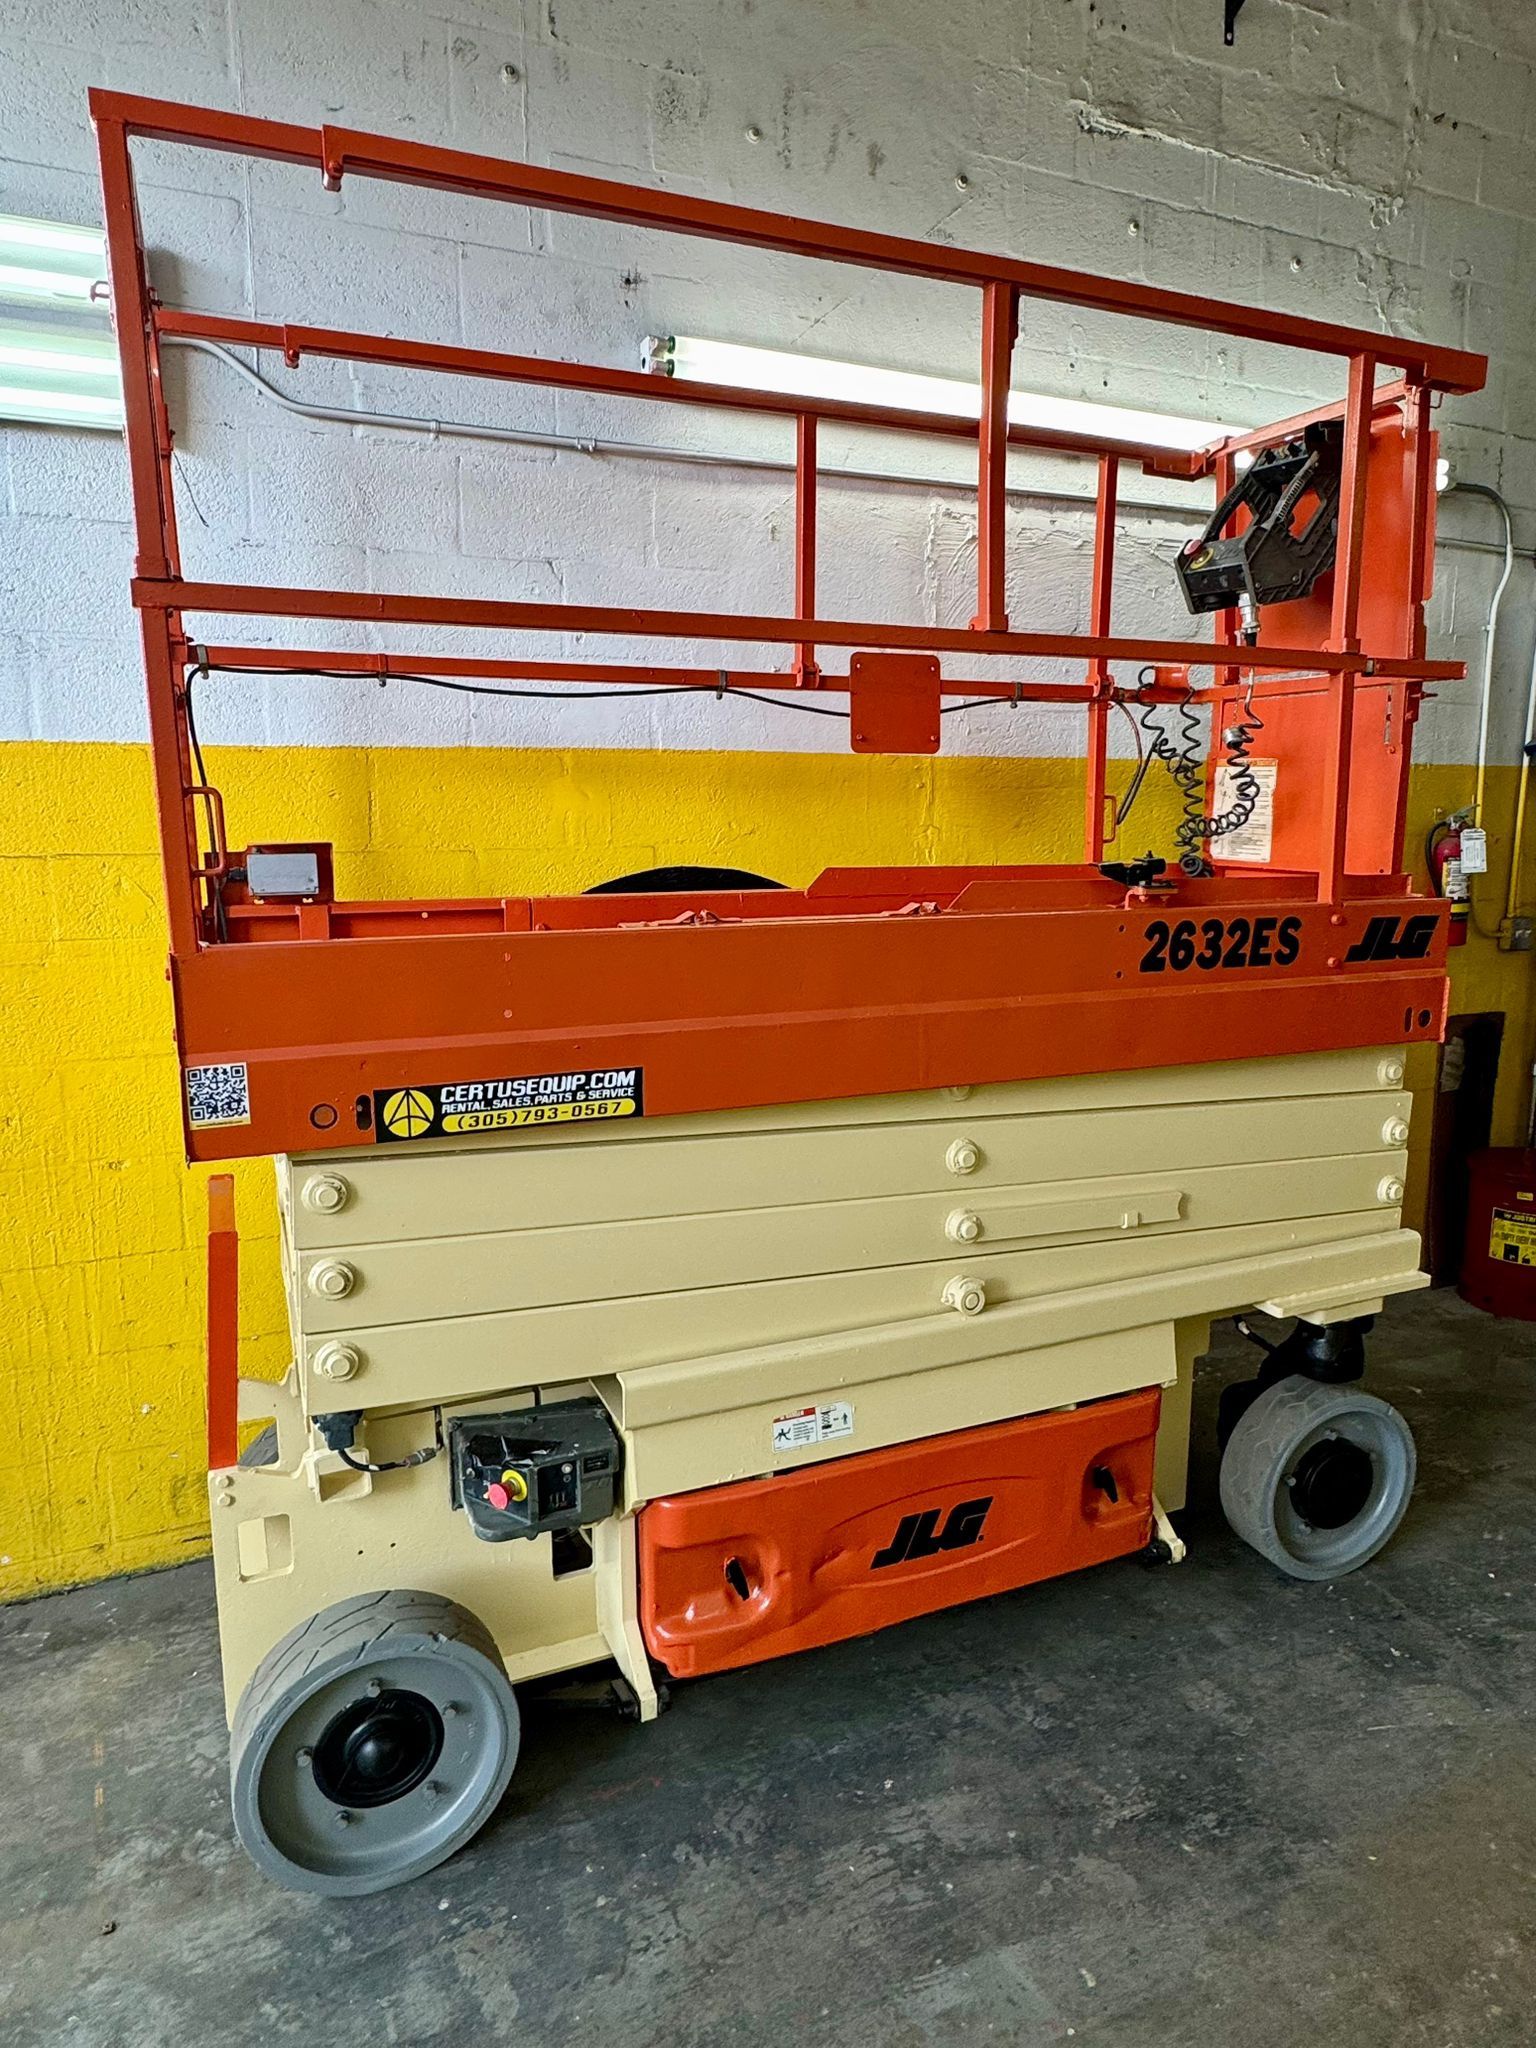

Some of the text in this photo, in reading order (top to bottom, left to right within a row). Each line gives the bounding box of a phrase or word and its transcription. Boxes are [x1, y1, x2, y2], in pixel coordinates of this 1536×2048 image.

[1140, 916, 1303, 973] 2632ES
[1345, 915, 1440, 962] JLG
[440, 1070, 635, 1103] CERTUSEQUIP.COM
[576, 1091, 586, 1101] &
[588, 1087, 635, 1100] SERVICE
[457, 1101, 622, 1130] (305)793-0567
[870, 1496, 993, 1570] JLG
